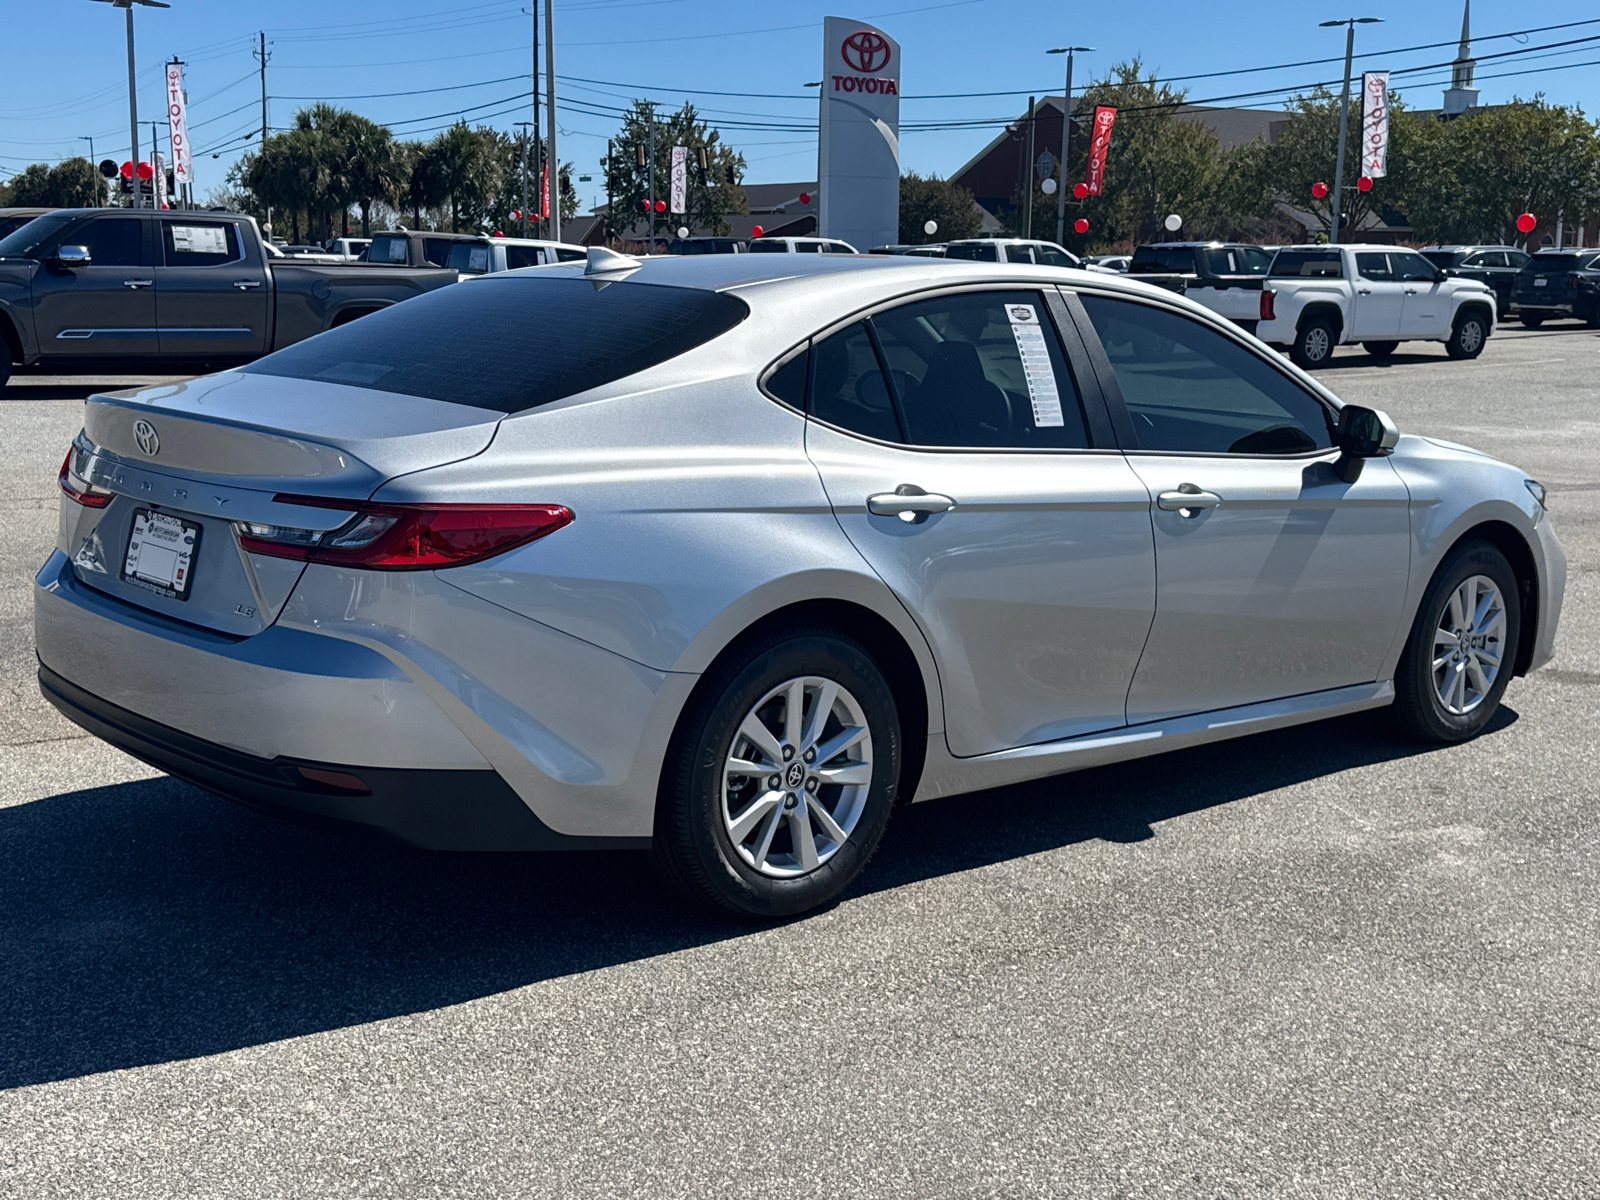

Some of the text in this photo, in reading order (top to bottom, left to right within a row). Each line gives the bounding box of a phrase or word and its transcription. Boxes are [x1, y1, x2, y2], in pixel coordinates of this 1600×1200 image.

[831, 75, 897, 95] TOYOTA
[170, 89, 186, 175] TOYOTA
[1089, 125, 1108, 192] TOYOTA
[1370, 95, 1382, 170] TOYOTA
[675, 160, 683, 209] TOYOTA
[234, 604, 256, 618] LE
